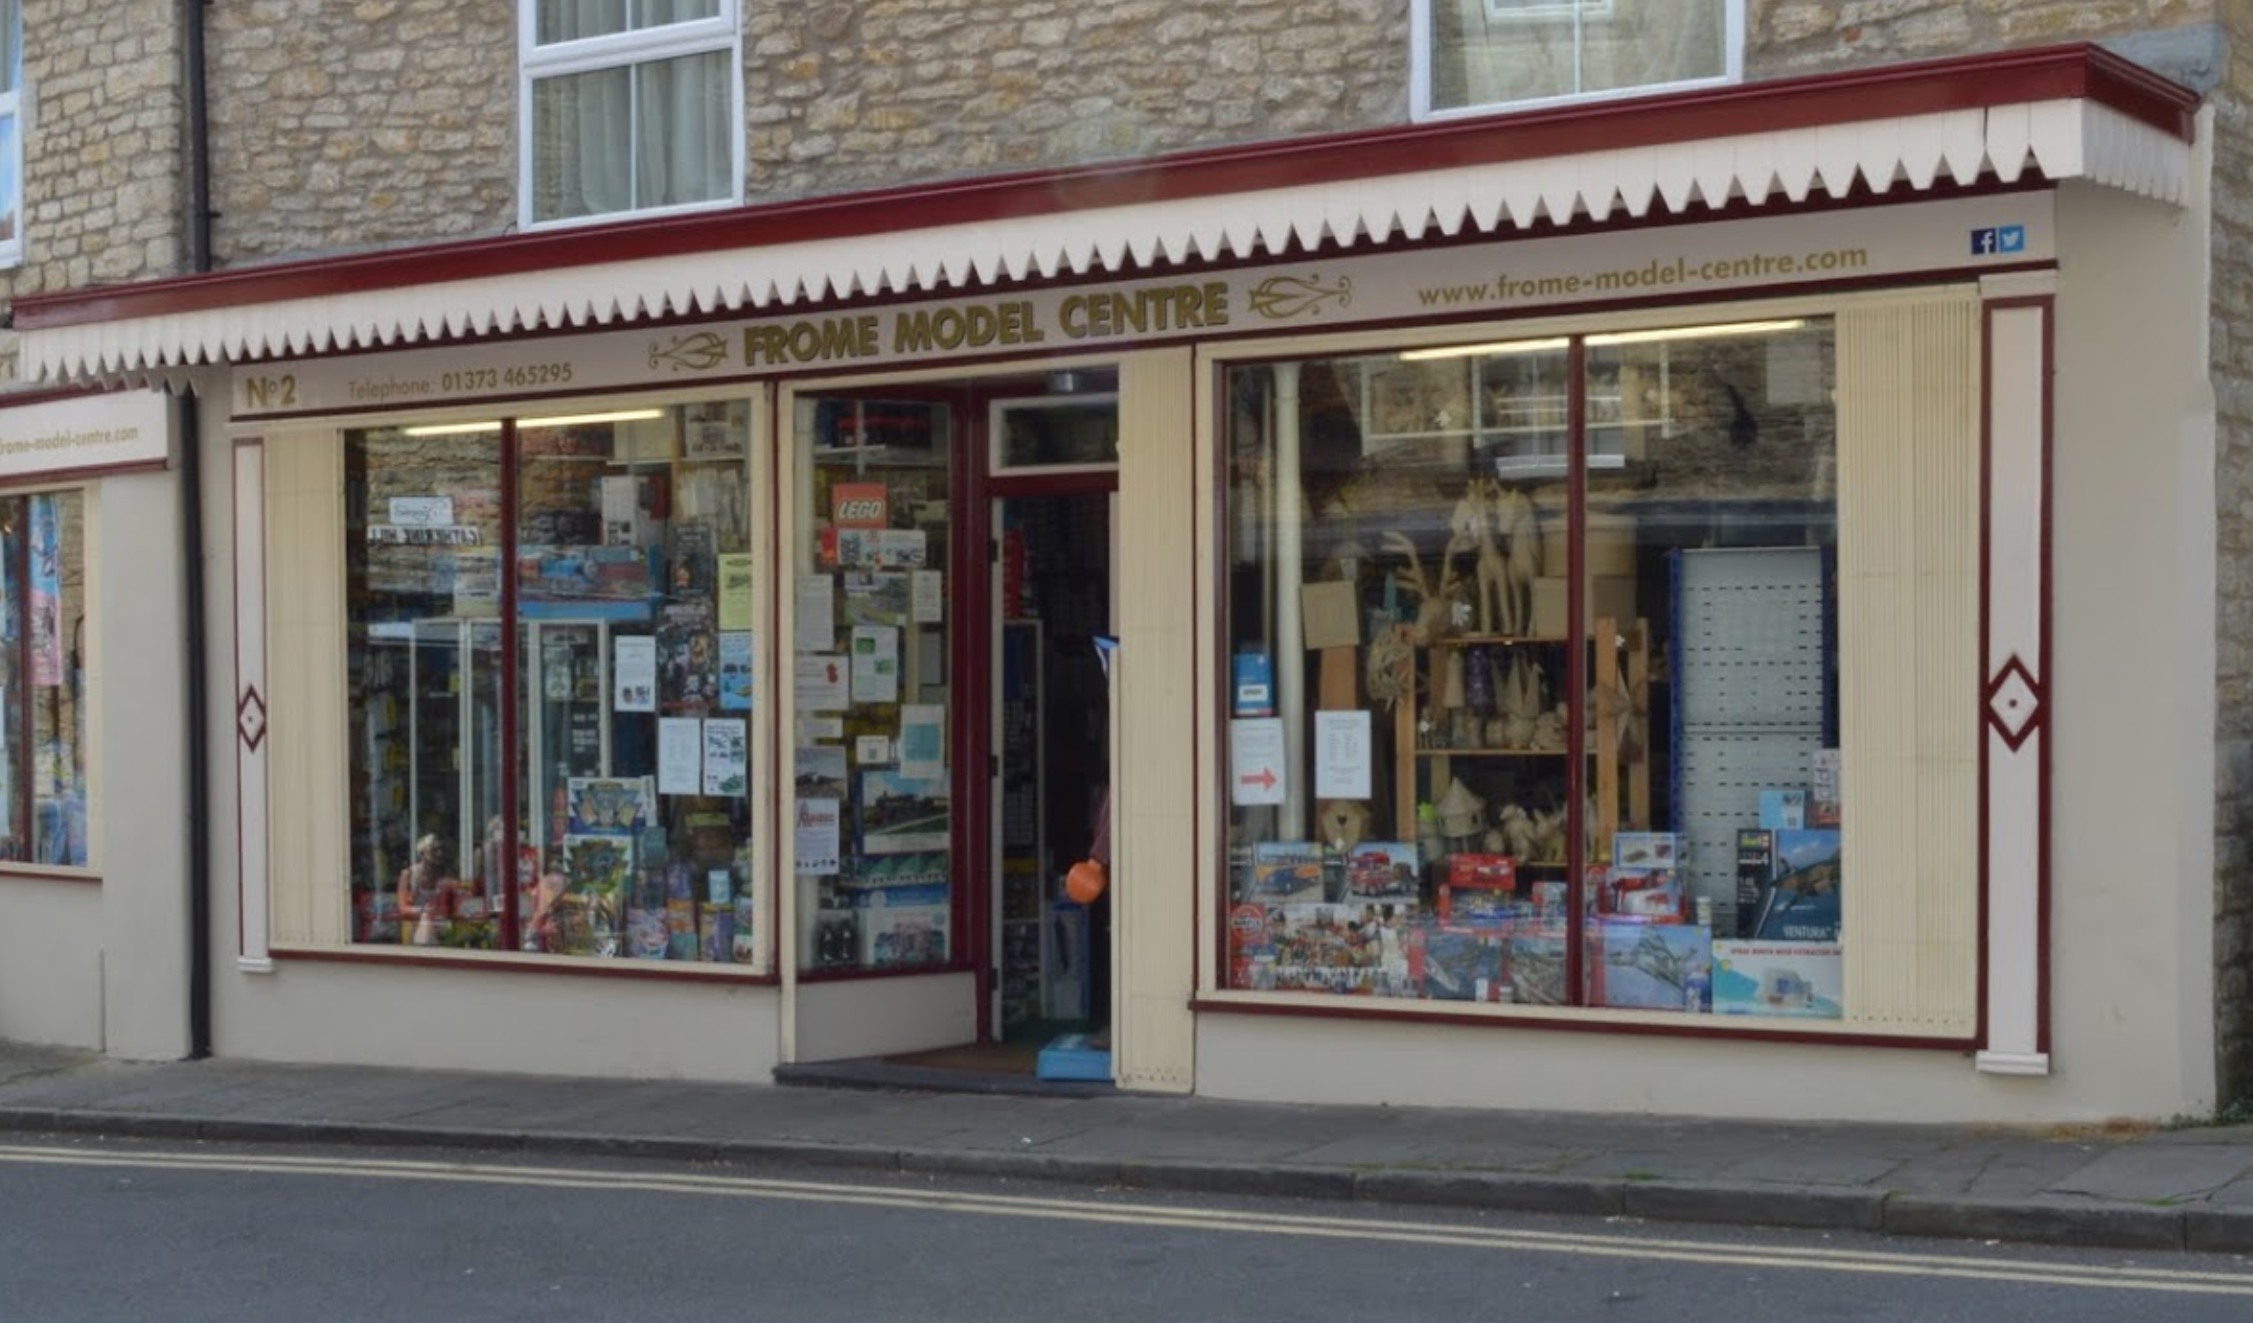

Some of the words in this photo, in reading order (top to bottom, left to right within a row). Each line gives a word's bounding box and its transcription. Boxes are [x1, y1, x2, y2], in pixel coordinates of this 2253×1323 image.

[1418, 247, 1869, 307] www.frome-model-centre.com
[744, 315, 879, 367] FROME
[894, 300, 1045, 353] MODEL
[1059, 281, 1229, 339] CENTRE
[348, 379, 437, 402] Telephone:
[440, 368, 498, 393] 01373
[502, 361, 574, 388] 465295
[838, 500, 883, 520] LEGO
